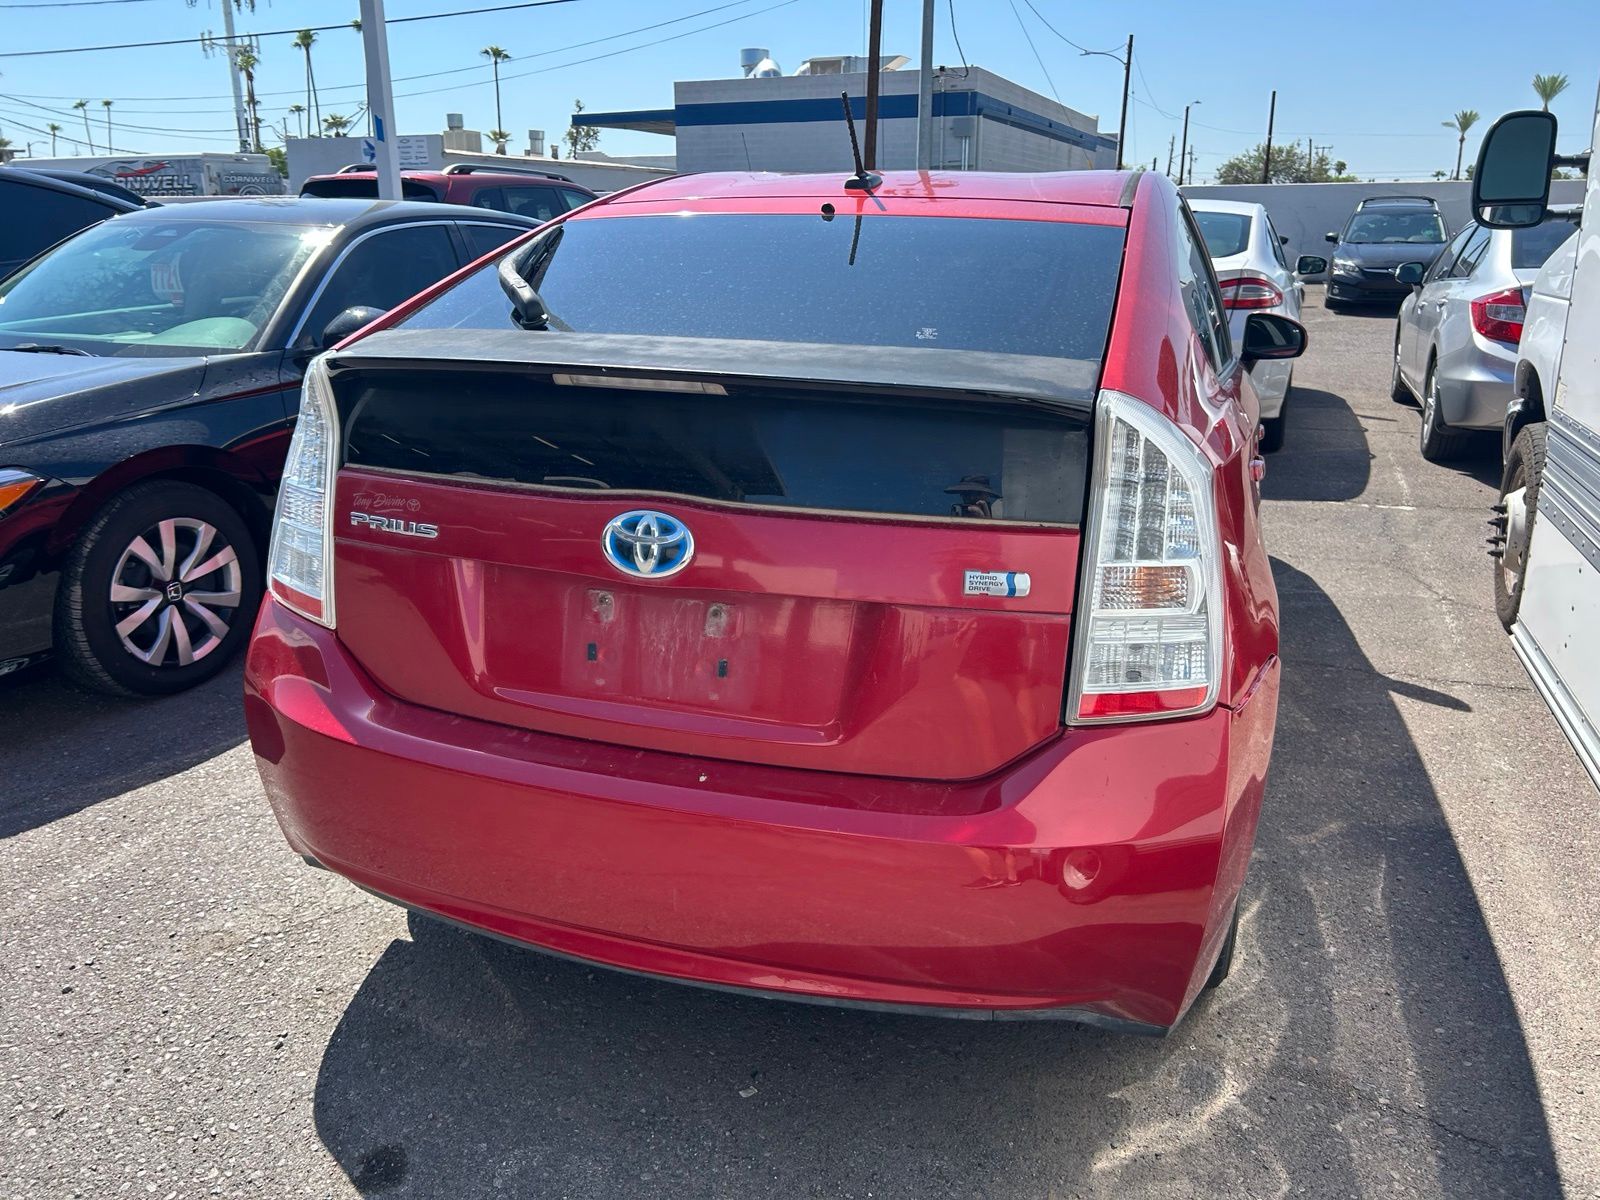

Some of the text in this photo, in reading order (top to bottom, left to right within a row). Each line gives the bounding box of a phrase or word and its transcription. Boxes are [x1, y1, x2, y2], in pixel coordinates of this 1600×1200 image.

[223, 175, 276, 184] CORNWELL
[353, 493, 371, 509] Tony
[350, 511, 438, 538] PRIUS
